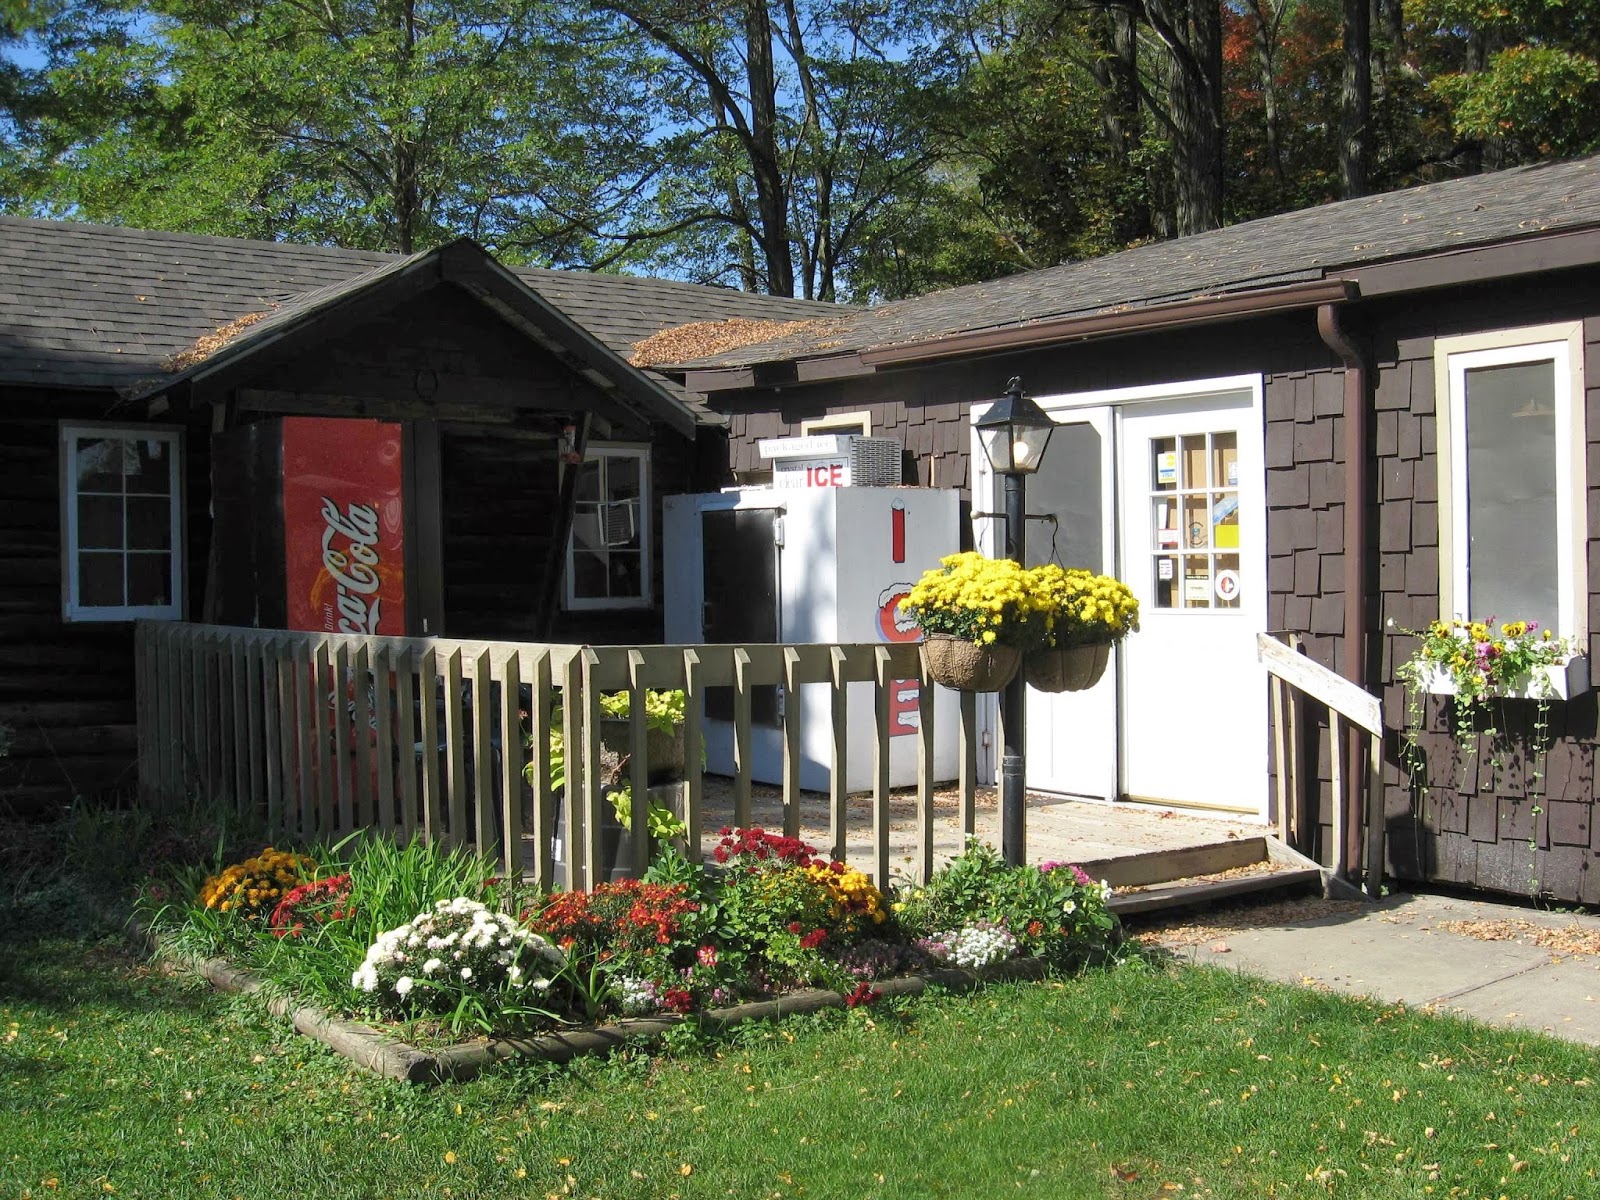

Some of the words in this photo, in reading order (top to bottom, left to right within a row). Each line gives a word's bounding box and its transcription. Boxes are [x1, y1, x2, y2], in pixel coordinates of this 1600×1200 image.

[806, 463, 843, 488] ICE
[322, 496, 380, 635] ca-Cola
[324, 602, 334, 631] Drink!
